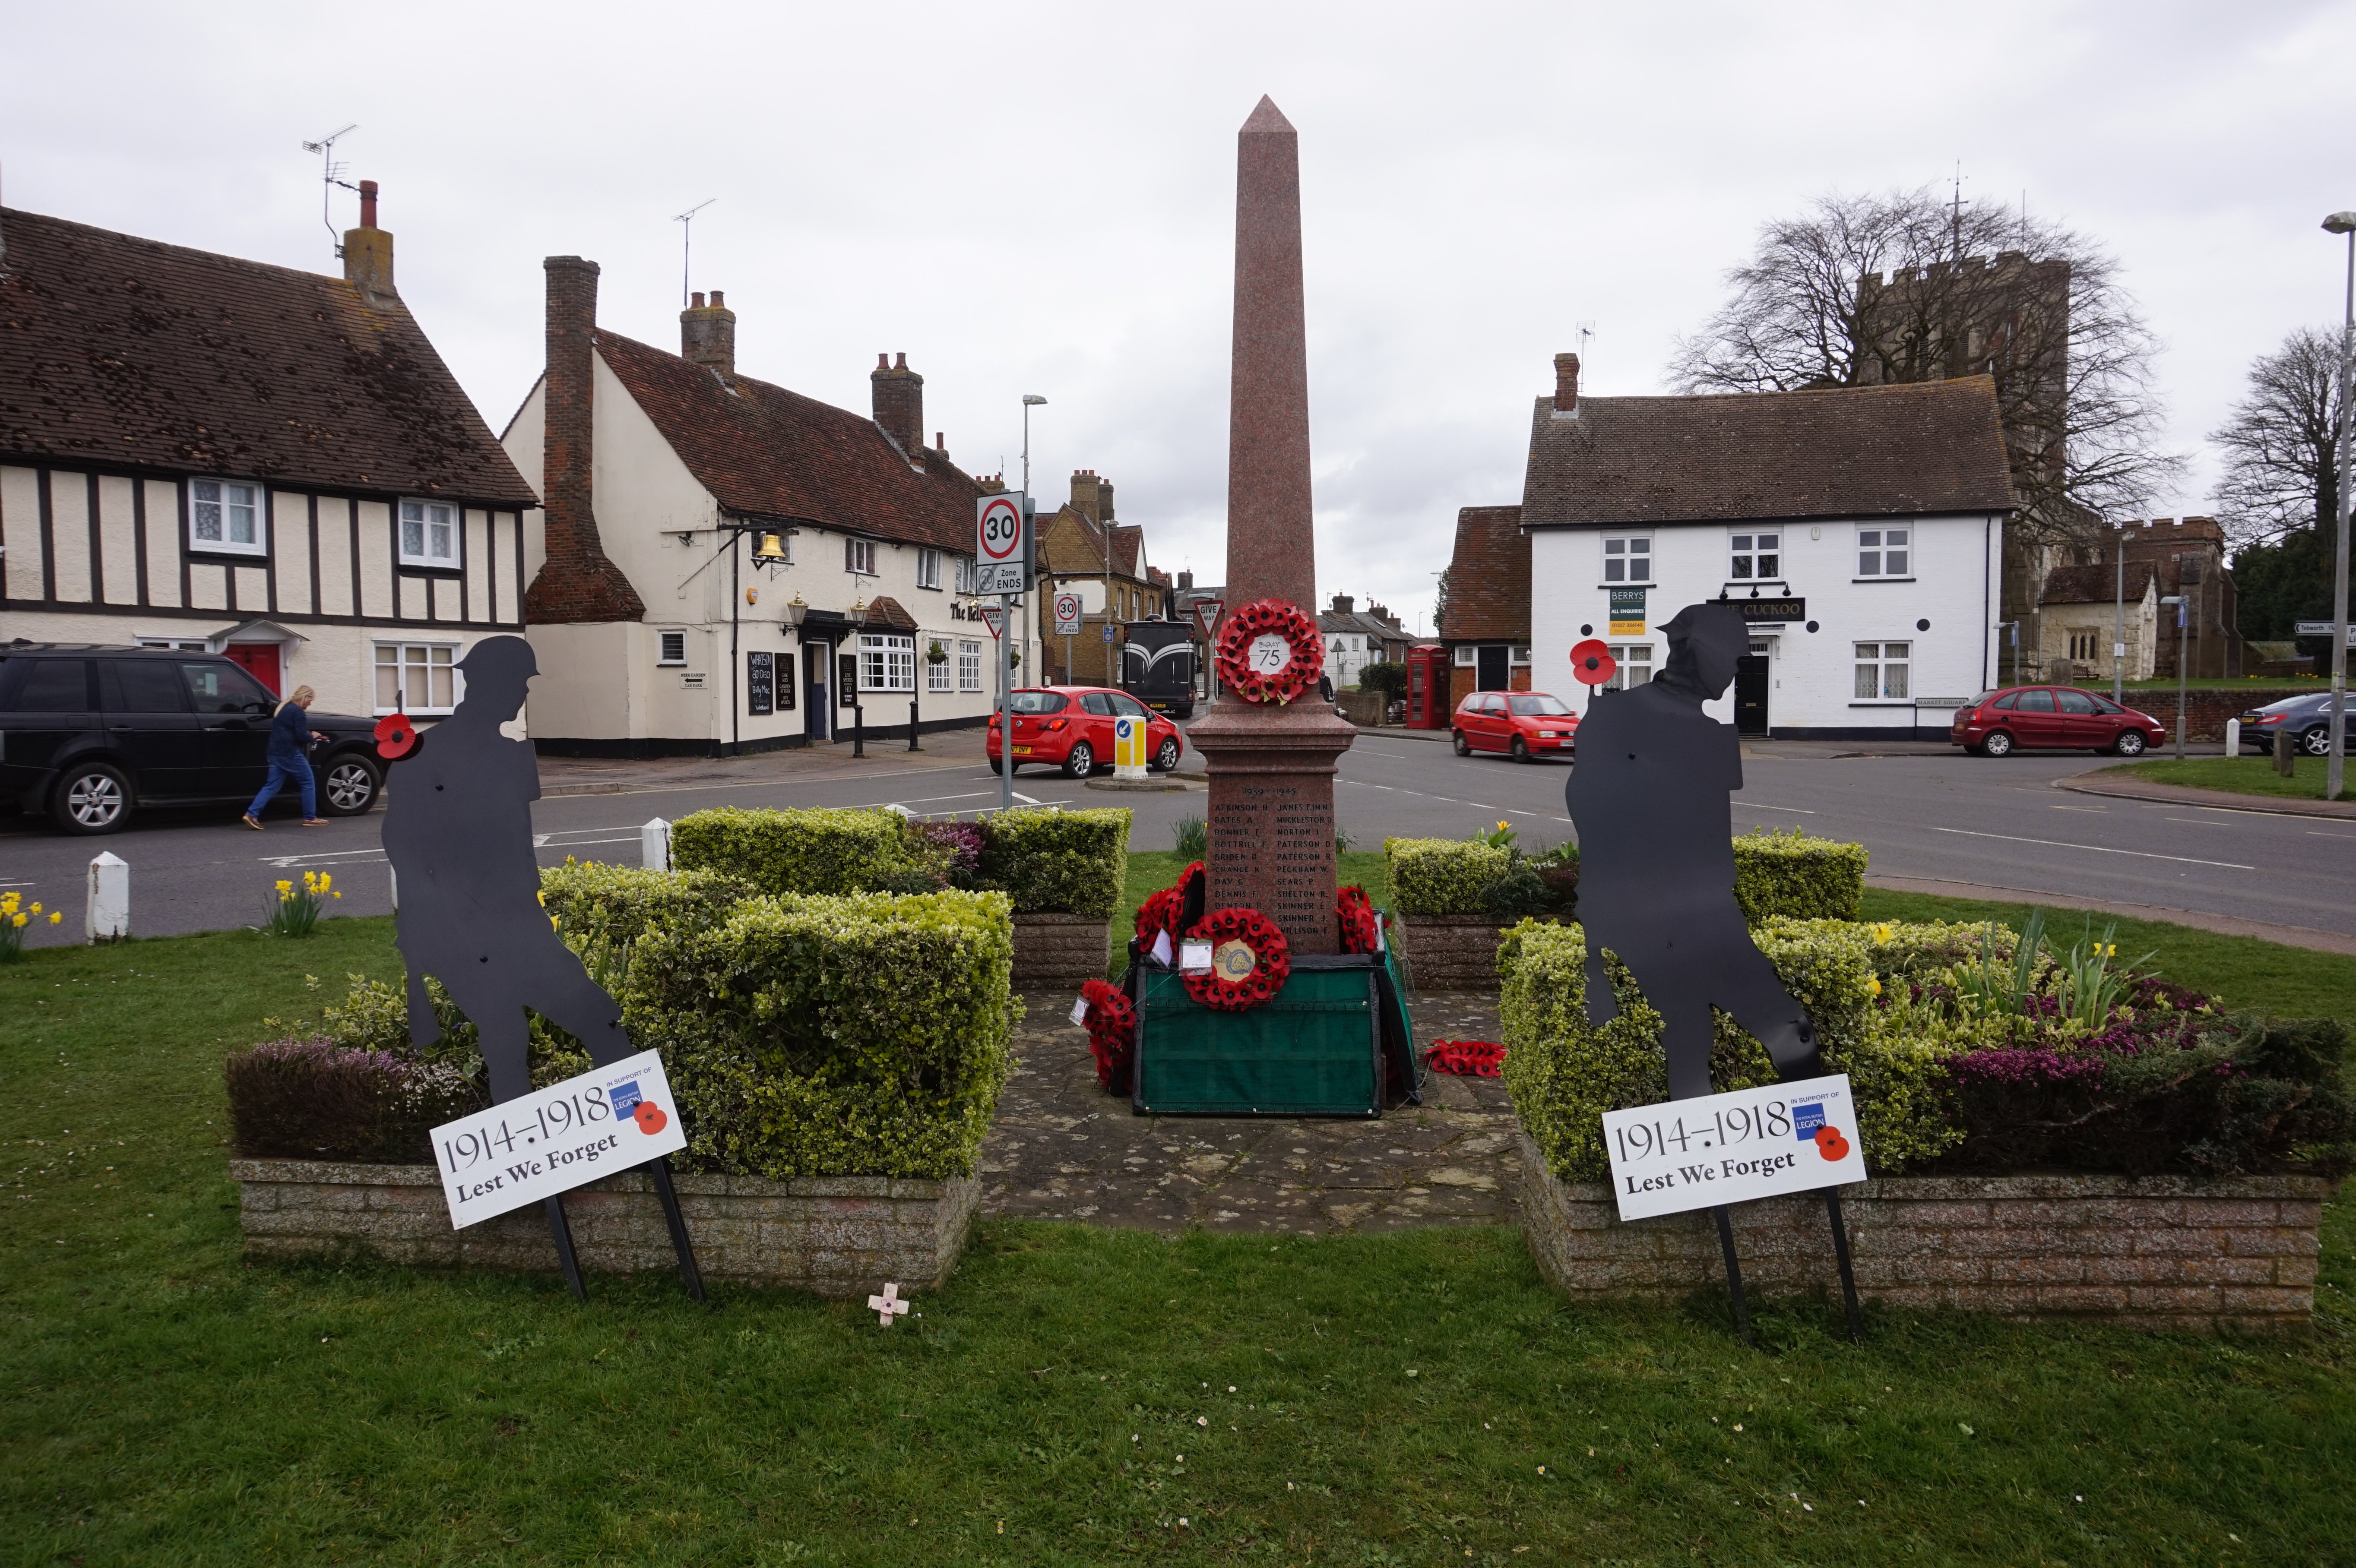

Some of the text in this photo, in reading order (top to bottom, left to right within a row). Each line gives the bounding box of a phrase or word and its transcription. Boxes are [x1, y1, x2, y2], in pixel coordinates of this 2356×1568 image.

[986, 515, 1014, 541] 30
[997, 578, 1021, 589] ENDS
[950, 601, 966, 620] The
[1060, 604, 1074, 613] 30
[1744, 604, 1800, 615] CUCKOO
[1260, 650, 1280, 666] 75
[614, 1071, 642, 1084] SUPPORT
[643, 1066, 652, 1075] OF
[614, 1095, 641, 1110] LEGION
[1799, 1093, 1829, 1103] SUPPORT
[1796, 1118, 1824, 1129] LEGION
[456, 1134, 618, 1204] Lest We Forget
[1625, 1152, 1796, 1195] Lest We Forget
